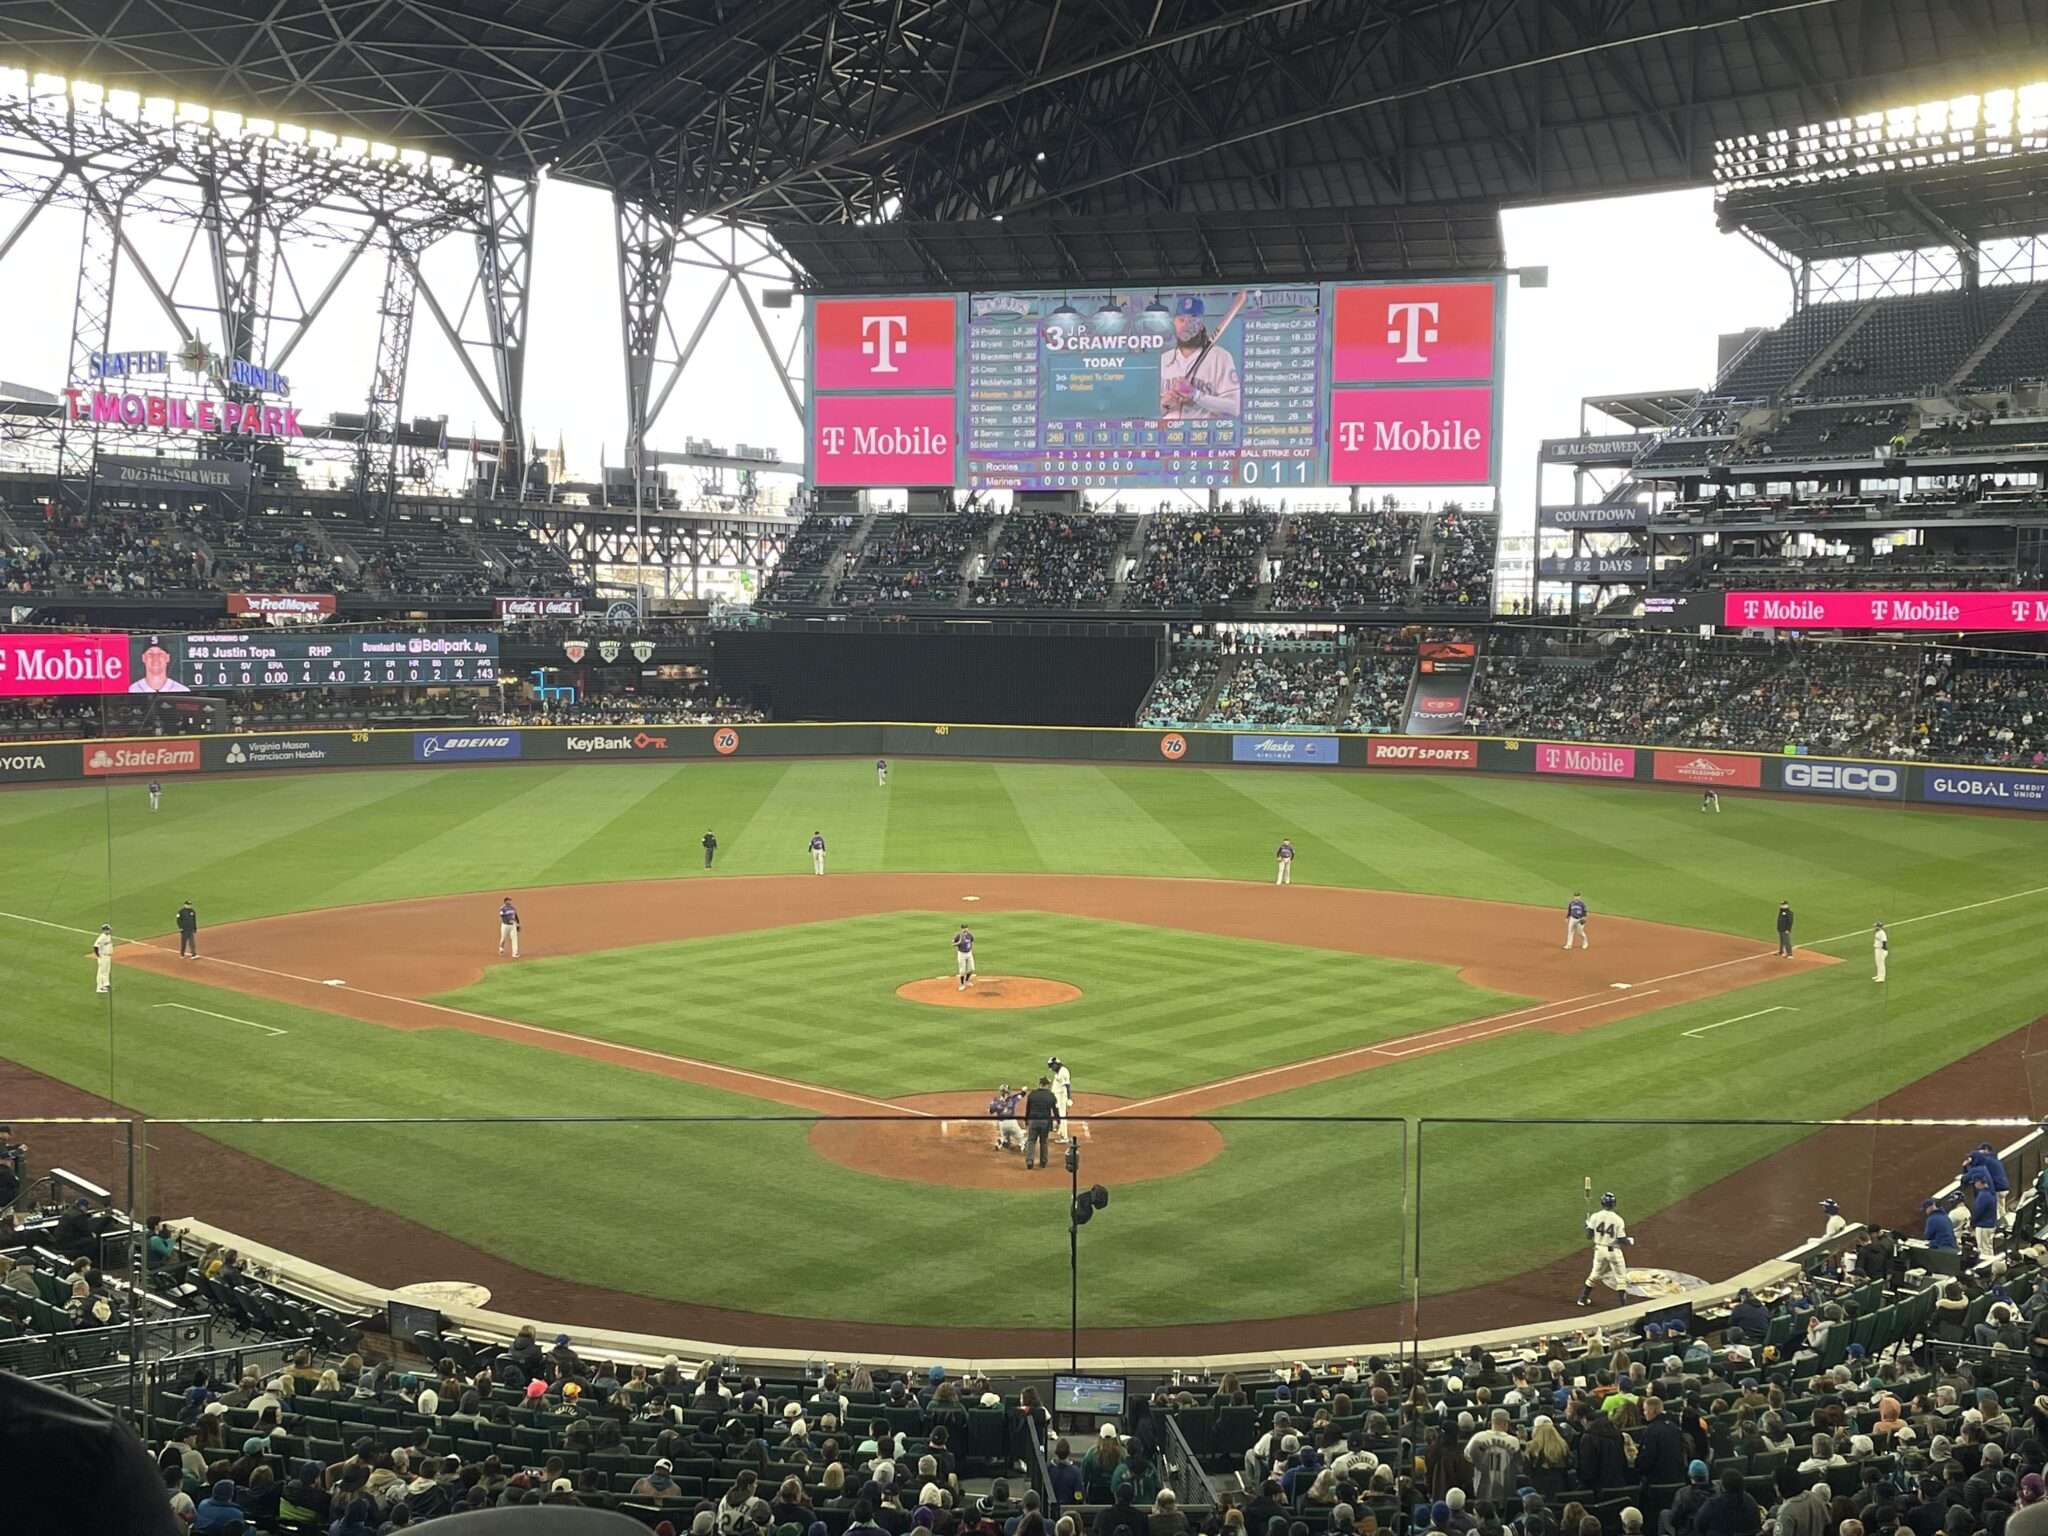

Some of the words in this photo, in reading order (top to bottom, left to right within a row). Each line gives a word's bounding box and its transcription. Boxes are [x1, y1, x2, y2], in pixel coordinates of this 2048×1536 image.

[1046, 326, 1065, 350] 3
[1067, 325, 1087, 336] J.P.
[1067, 335, 1164, 350] CRAWFORD
[1083, 357, 1125, 368] TODAY
[62, 388, 216, 431] T-MOBILE
[222, 401, 304, 437] PARK
[822, 427, 845, 455] T
[852, 426, 947, 455] Mobile
[1339, 422, 1365, 451] T
[1374, 420, 1481, 451] Mobile
[1241, 449, 1259, 457] BALL
[1262, 449, 1290, 457] STRIKE
[1293, 449, 1311, 457] OUT
[986, 462, 1018, 471] Rockies
[1044, 461, 1051, 471] 0
[1058, 461, 1065, 471] 0
[1072, 461, 1078, 471] 0
[1085, 461, 1092, 471] 0
[1099, 461, 1106, 471] 0
[1112, 461, 1119, 471] 0
[1126, 461, 1133, 471] 0
[1173, 461, 1180, 471] 0
[1190, 461, 1197, 471] 2
[1208, 461, 1213, 471] 1
[1223, 460, 1230, 471] 2
[1243, 461, 1258, 484] 0
[1271, 461, 1281, 483] 1
[1295, 461, 1306, 483] 1
[199, 470, 231, 486] WEEK
[986, 477, 1021, 486] Mariners
[1044, 475, 1051, 486] 0
[1058, 475, 1065, 486] 0
[1072, 475, 1078, 486] 0
[1085, 475, 1092, 486] 0
[1099, 475, 1106, 486] 0
[1113, 476, 1118, 486] 1
[1173, 475, 1178, 485] 1
[1189, 475, 1197, 485] 4
[1206, 475, 1214, 485] 0
[1222, 475, 1229, 485] 4
[1555, 508, 1636, 523] COUNTDOWN
[1574, 560, 1591, 572] 82
[1600, 559, 1632, 572] DAYS
[1763, 599, 1825, 620] Mobile
[1892, 600, 1960, 621] Mobile
[188, 647, 209, 659] #48
[213, 647, 247, 658] Justin
[249, 647, 276, 659] Topa
[308, 646, 332, 657] RHP
[423, 639, 471, 654] Ballpark
[474, 643, 487, 653] App
[604, 648, 616, 657] 24
[639, 648, 647, 657] 11
[15, 648, 122, 681] Mobile
[194, 673, 203, 685] 0
[218, 673, 226, 684] 0
[242, 672, 250, 683] 0
[264, 672, 288, 683] 0.00
[302, 671, 310, 682] 4
[328, 671, 346, 682] 4.0
[364, 671, 371, 681] 2
[387, 670, 394, 680] 0
[410, 670, 418, 680] 0
[433, 670, 441, 680] 2
[456, 668, 463, 679] 4
[473, 668, 493, 679] .143
[1413, 711, 1464, 719] TOYOTA
[352, 733, 369, 742] 376
[935, 726, 949, 736] 401
[249, 742, 280, 753] Virginia
[282, 741, 310, 750] Mason
[444, 737, 511, 749] BOEING
[567, 736, 632, 752] KeyBank
[718, 734, 735, 747] 76
[1165, 739, 1182, 753] 76
[1254, 738, 1296, 753] Alaska
[249, 751, 294, 761] Franciscan
[295, 749, 324, 759] Health
[1376, 745, 1418, 758] ROOT
[1418, 749, 1470, 760] SPORTS
[0, 756, 46, 770] YOTA
[1564, 750, 1625, 772] Mobile
[1785, 763, 1897, 793] GEICO
[1934, 778, 2009, 797] GLOBAL
[2013, 783, 2046, 792] CREDIT
[2014, 791, 2042, 799] UNION
[1596, 1221, 1616, 1238] 44
[1490, 1453, 1501, 1471] 11
[722, 1513, 745, 1532] 24
